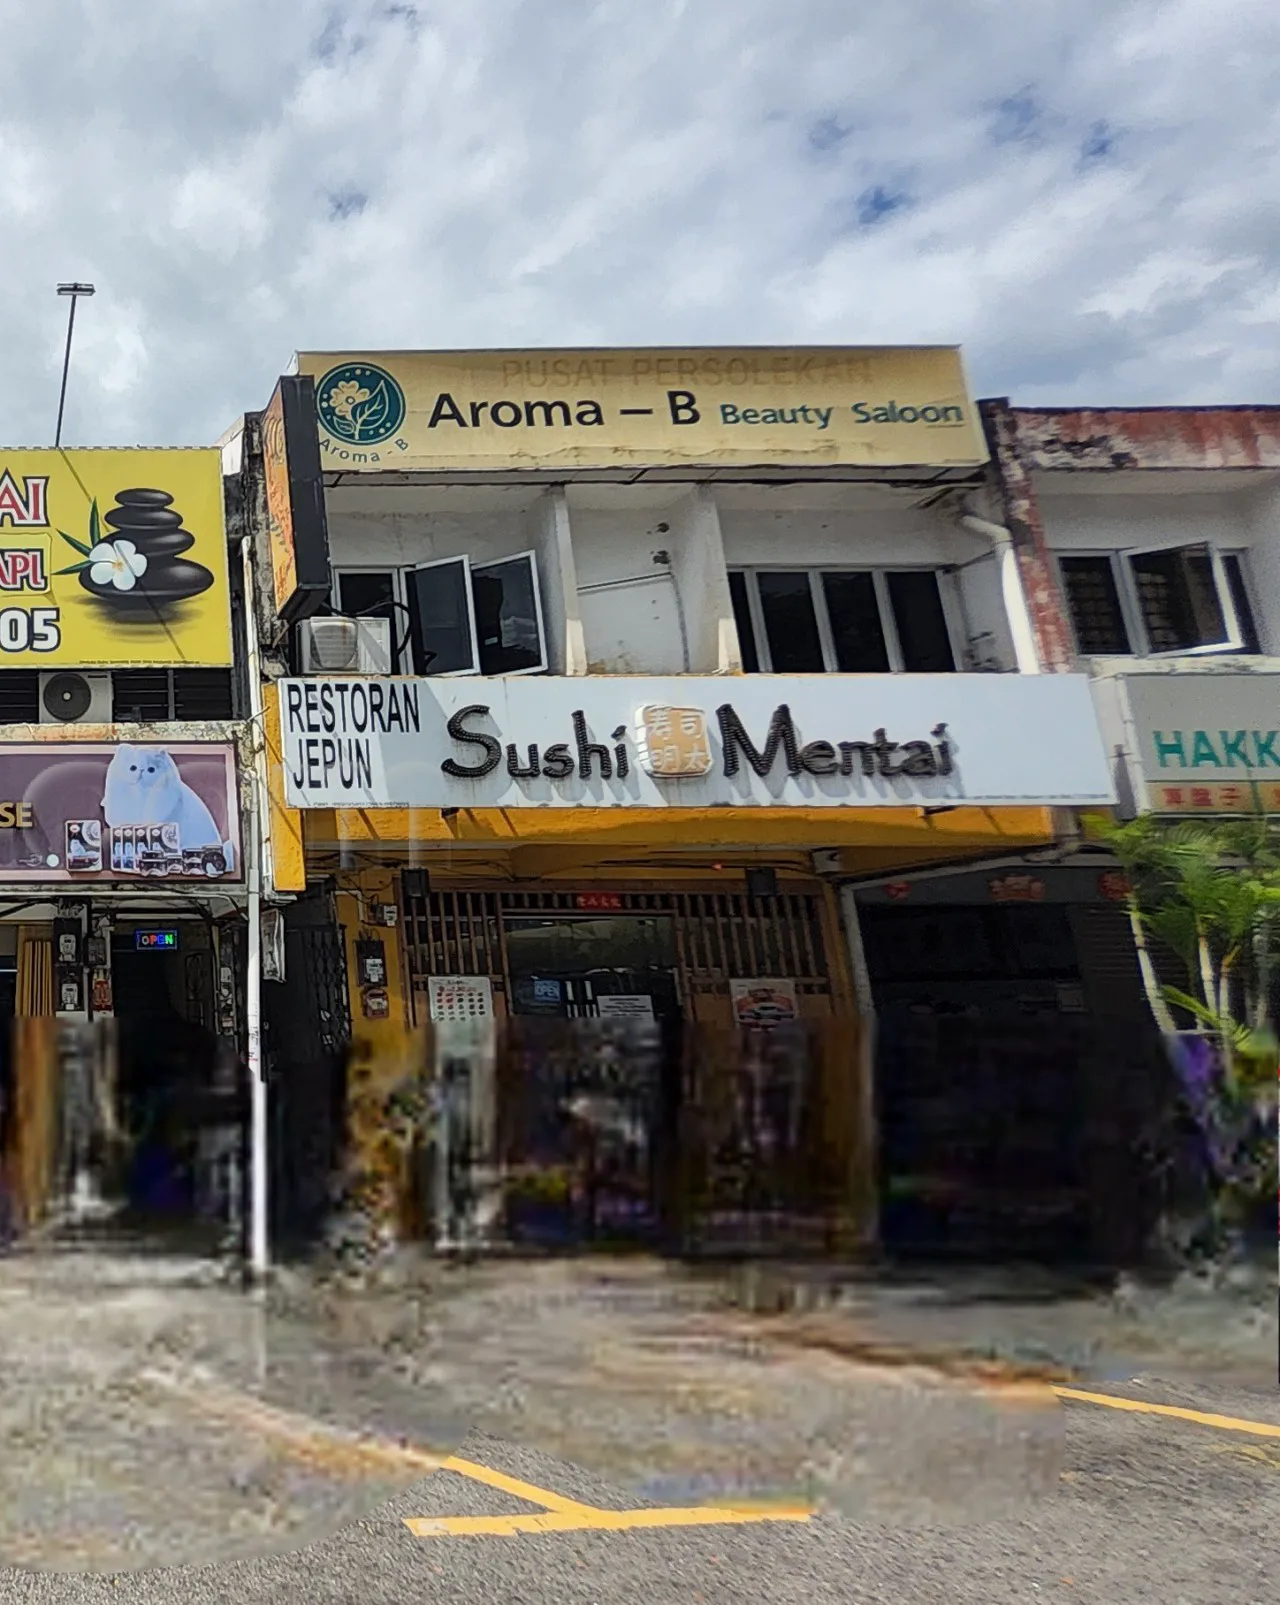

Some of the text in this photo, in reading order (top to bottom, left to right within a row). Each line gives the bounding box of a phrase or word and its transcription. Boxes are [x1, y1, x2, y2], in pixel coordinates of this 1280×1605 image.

[502, 358, 613, 387] PUSAT
[427, 392, 604, 428] Aroma
[667, 390, 700, 425] B
[720, 400, 963, 429] Beauty Saloon
[320, 437, 381, 463] Aroma
[394, 438, 409, 452] B
[288, 682, 420, 733] RESTORAN
[441, 703, 629, 779] Sushi
[715, 703, 952, 778] Mentai
[1152, 730, 1280, 768] HAKK
[293, 738, 373, 789] JEPUN
[142, 934, 174, 945] OPEN
